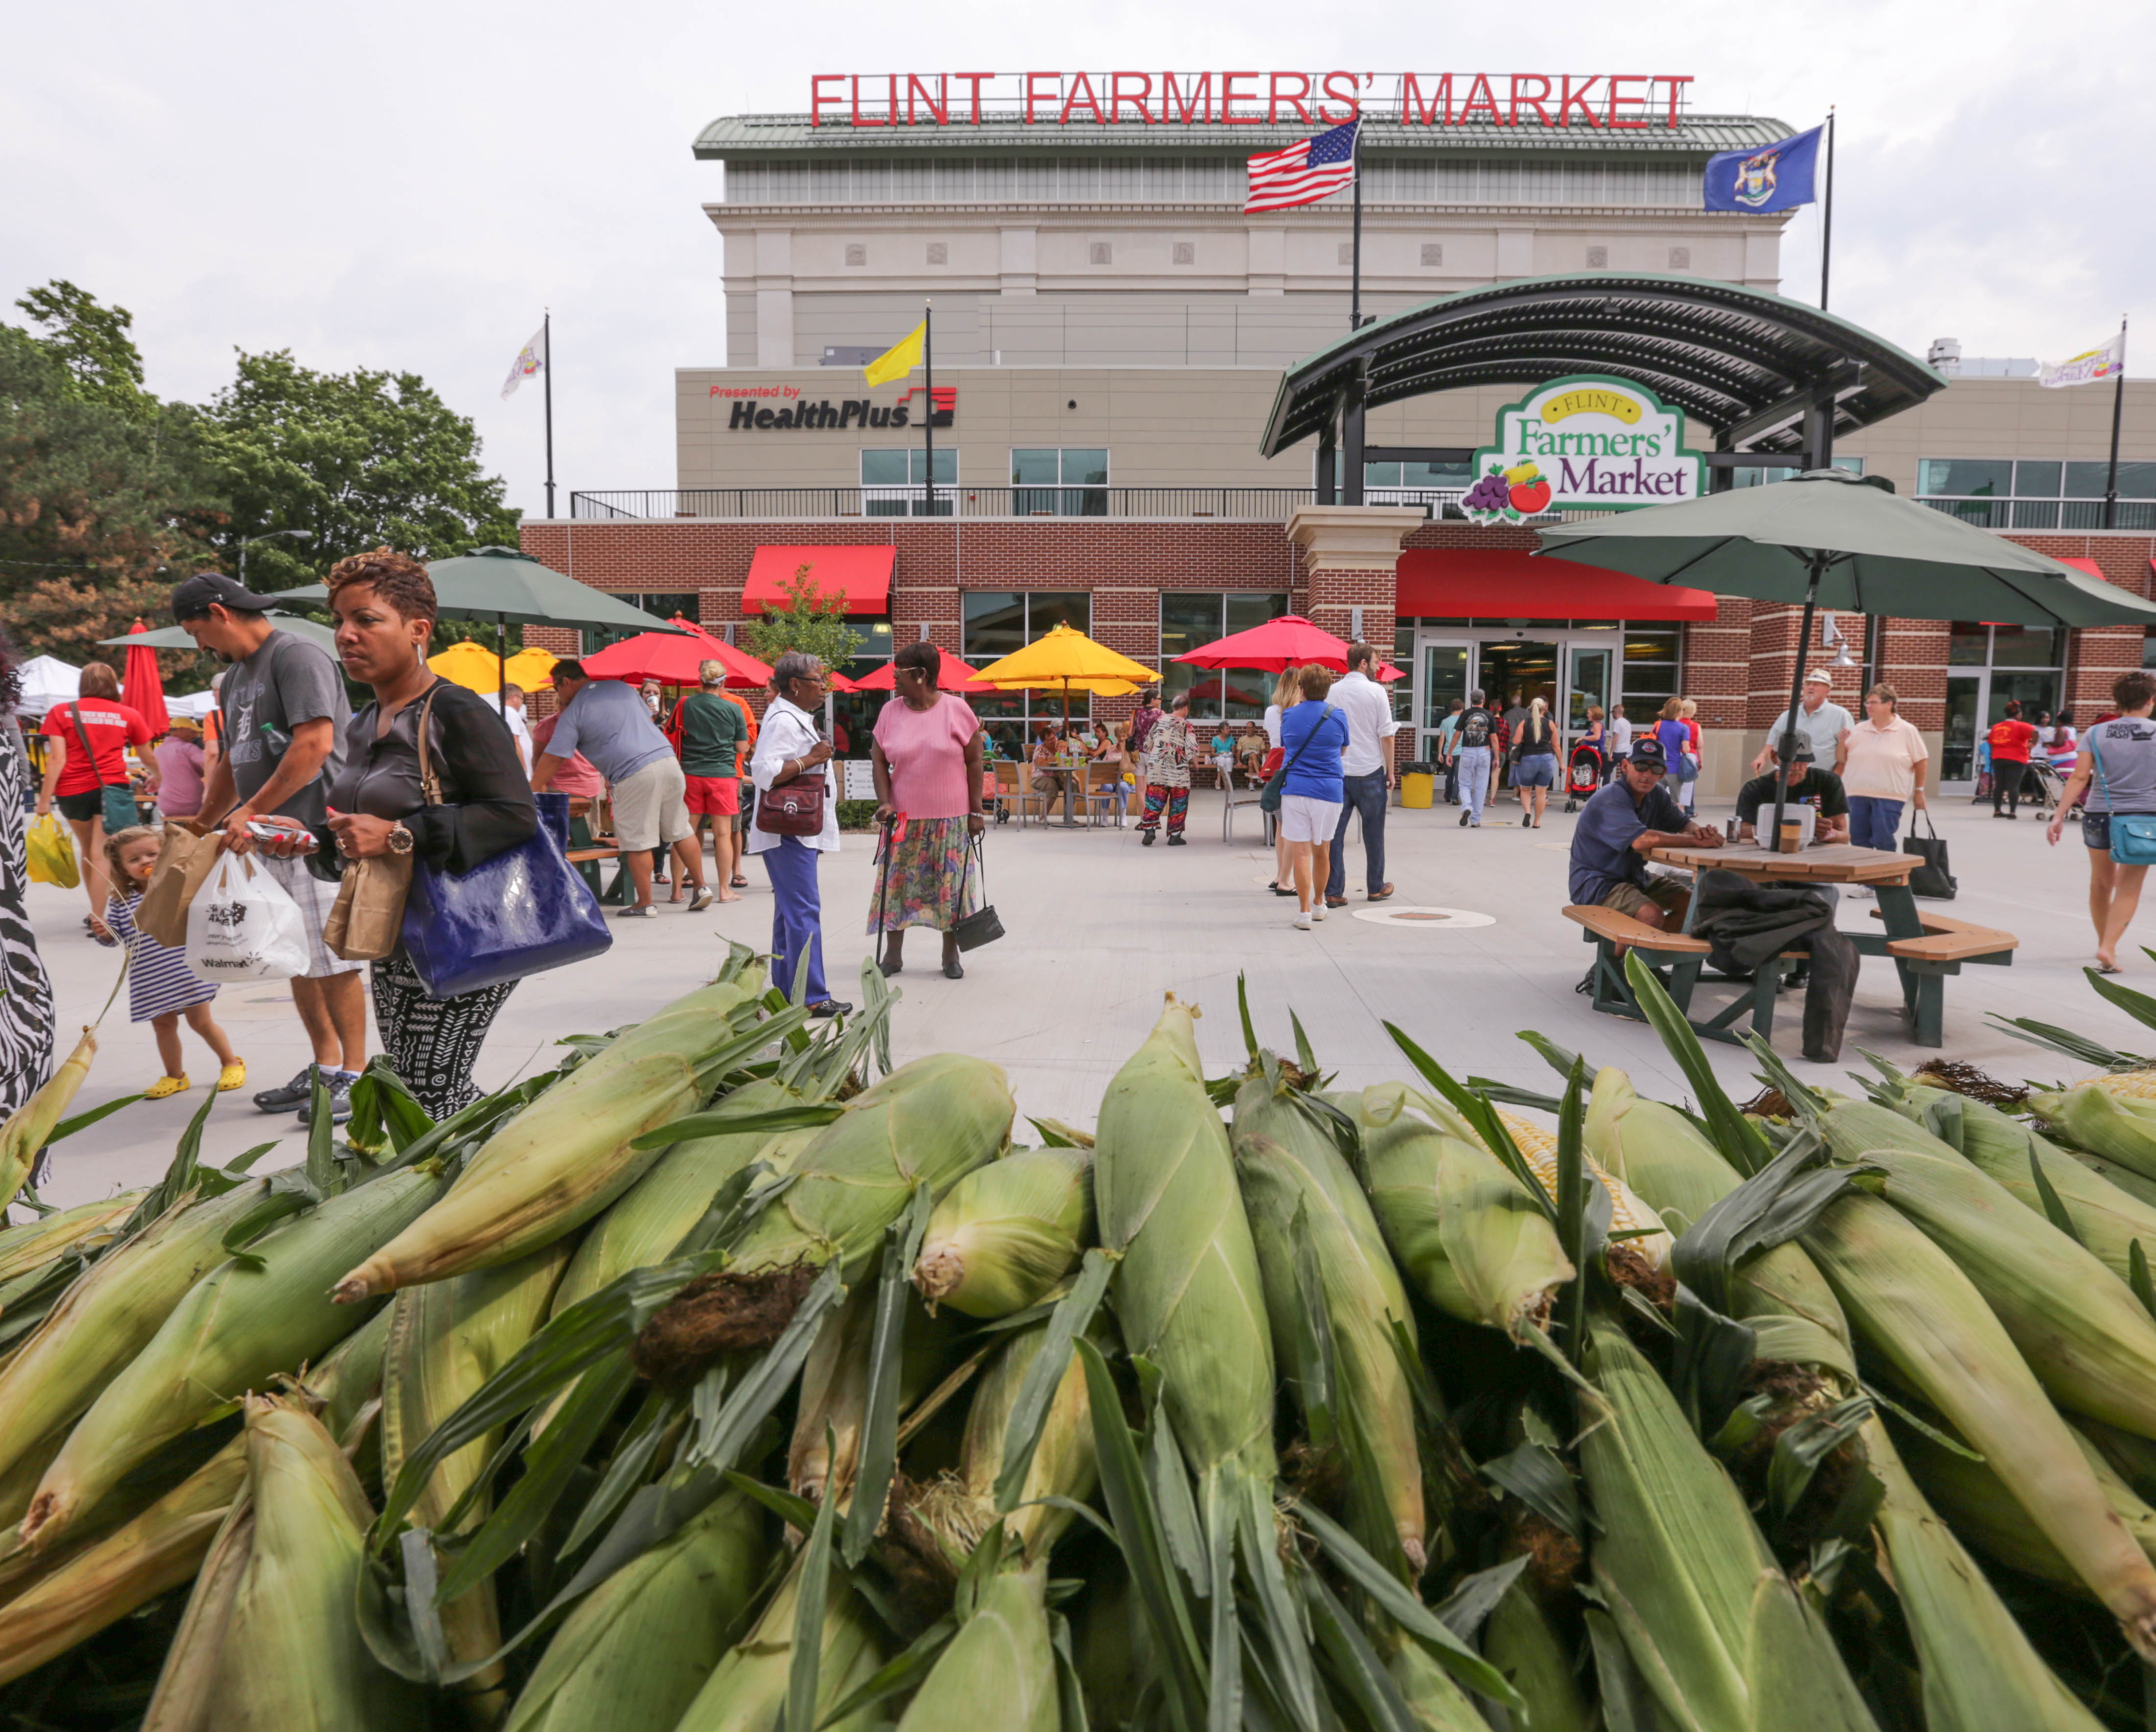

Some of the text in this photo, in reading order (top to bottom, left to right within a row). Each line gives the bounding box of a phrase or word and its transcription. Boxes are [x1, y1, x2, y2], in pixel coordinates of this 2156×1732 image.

[810, 72, 995, 127] FLINT
[1402, 72, 1694, 129] MARKET
[709, 385, 801, 400] Presented by
[1563, 393, 1623, 412] FLINT
[729, 400, 909, 429] HealthPlus
[1557, 457, 1687, 496] Market
